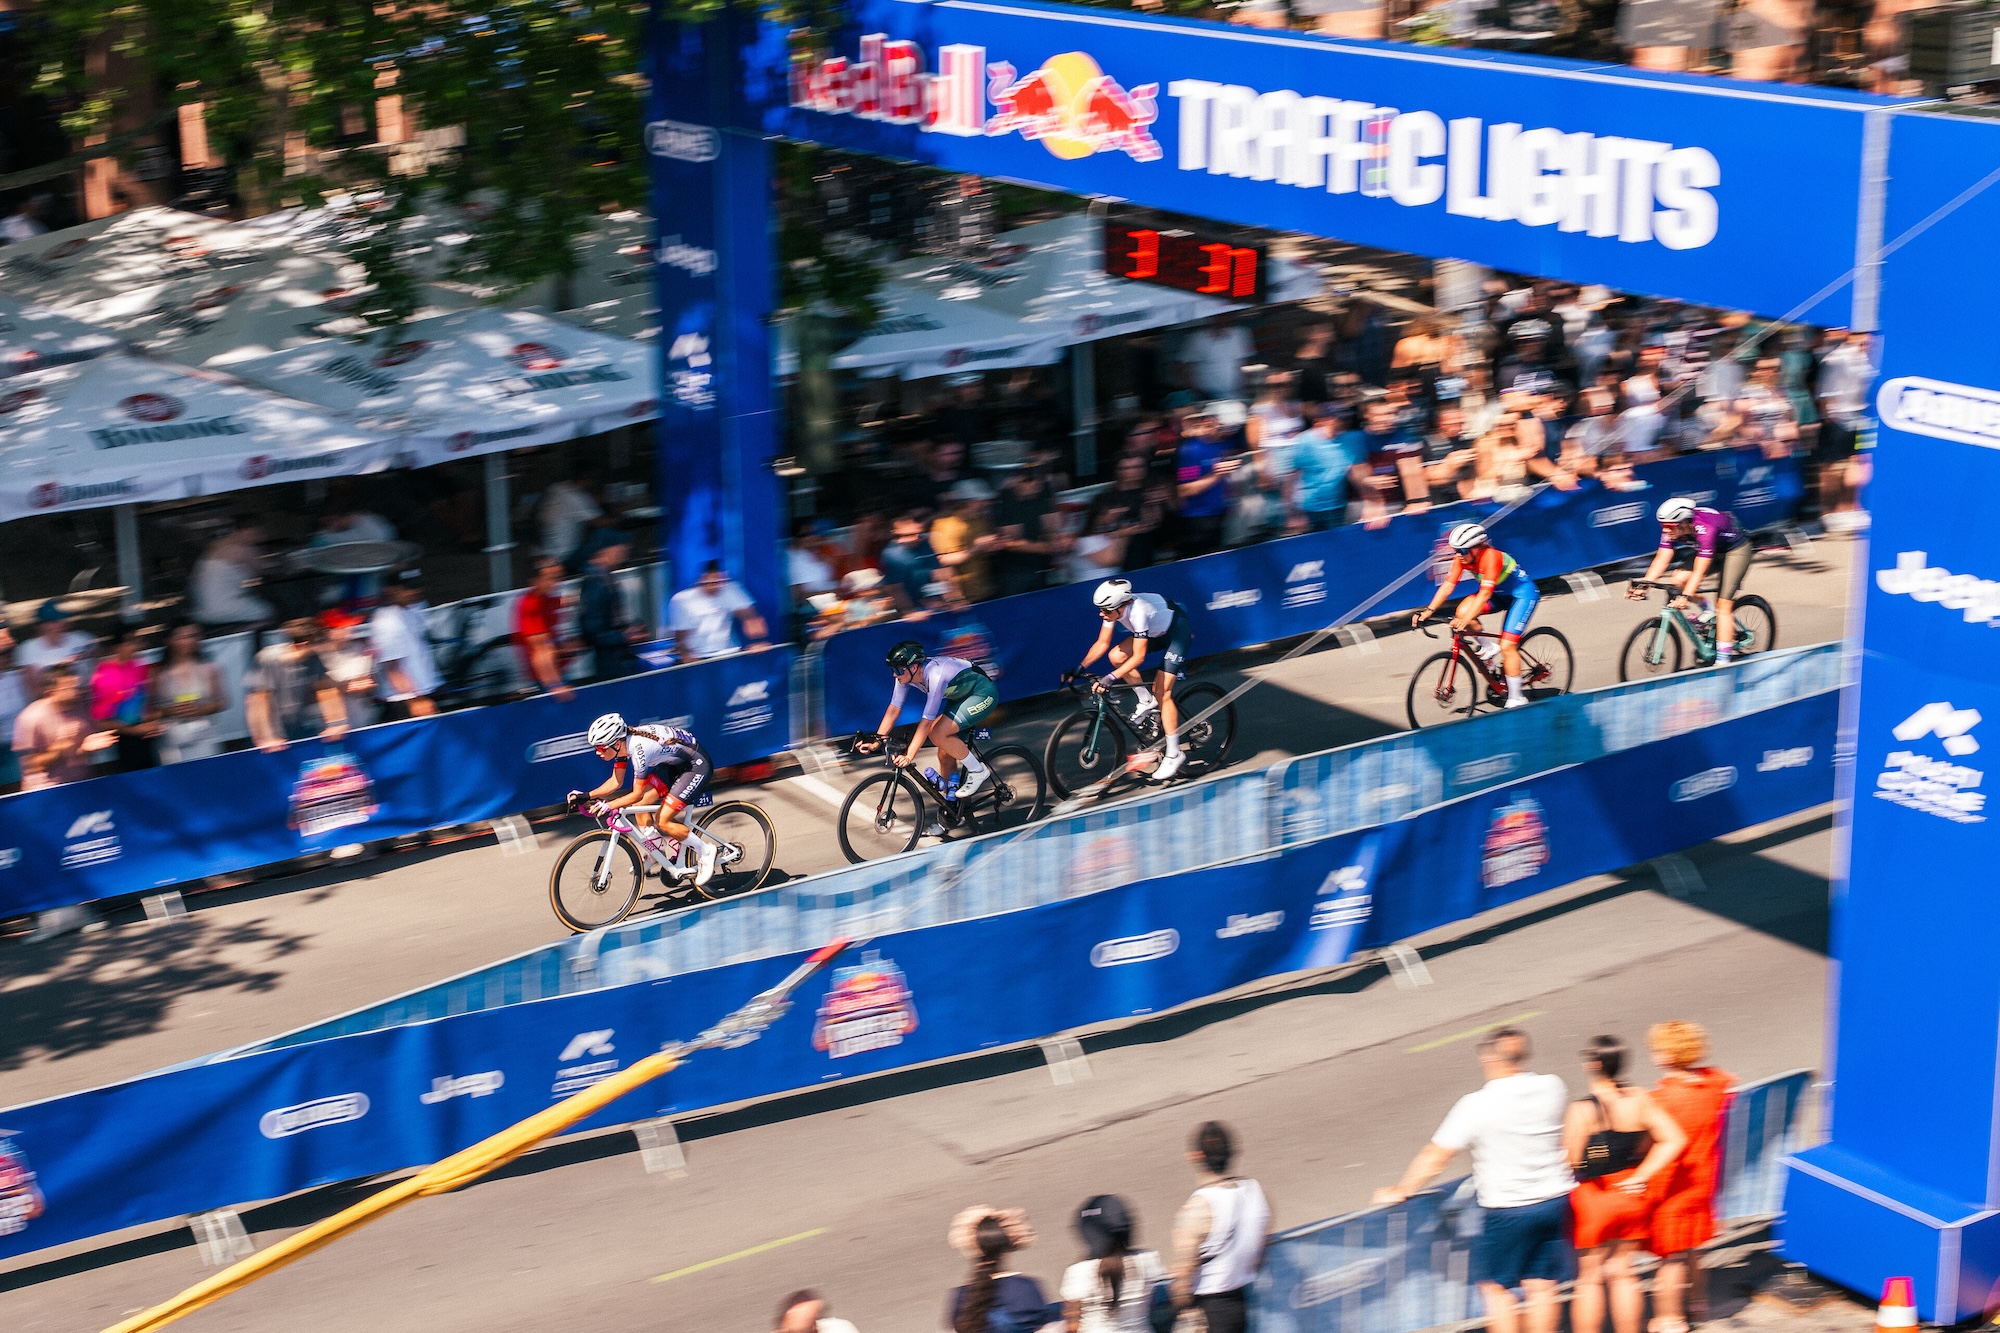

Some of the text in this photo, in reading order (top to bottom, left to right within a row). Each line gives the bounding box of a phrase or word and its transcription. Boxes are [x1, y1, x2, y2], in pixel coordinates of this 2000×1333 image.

[1446, 116, 1721, 251] LIGHTS
[679, 773, 702, 800] BROSCH
[699, 796, 709, 804] 211
